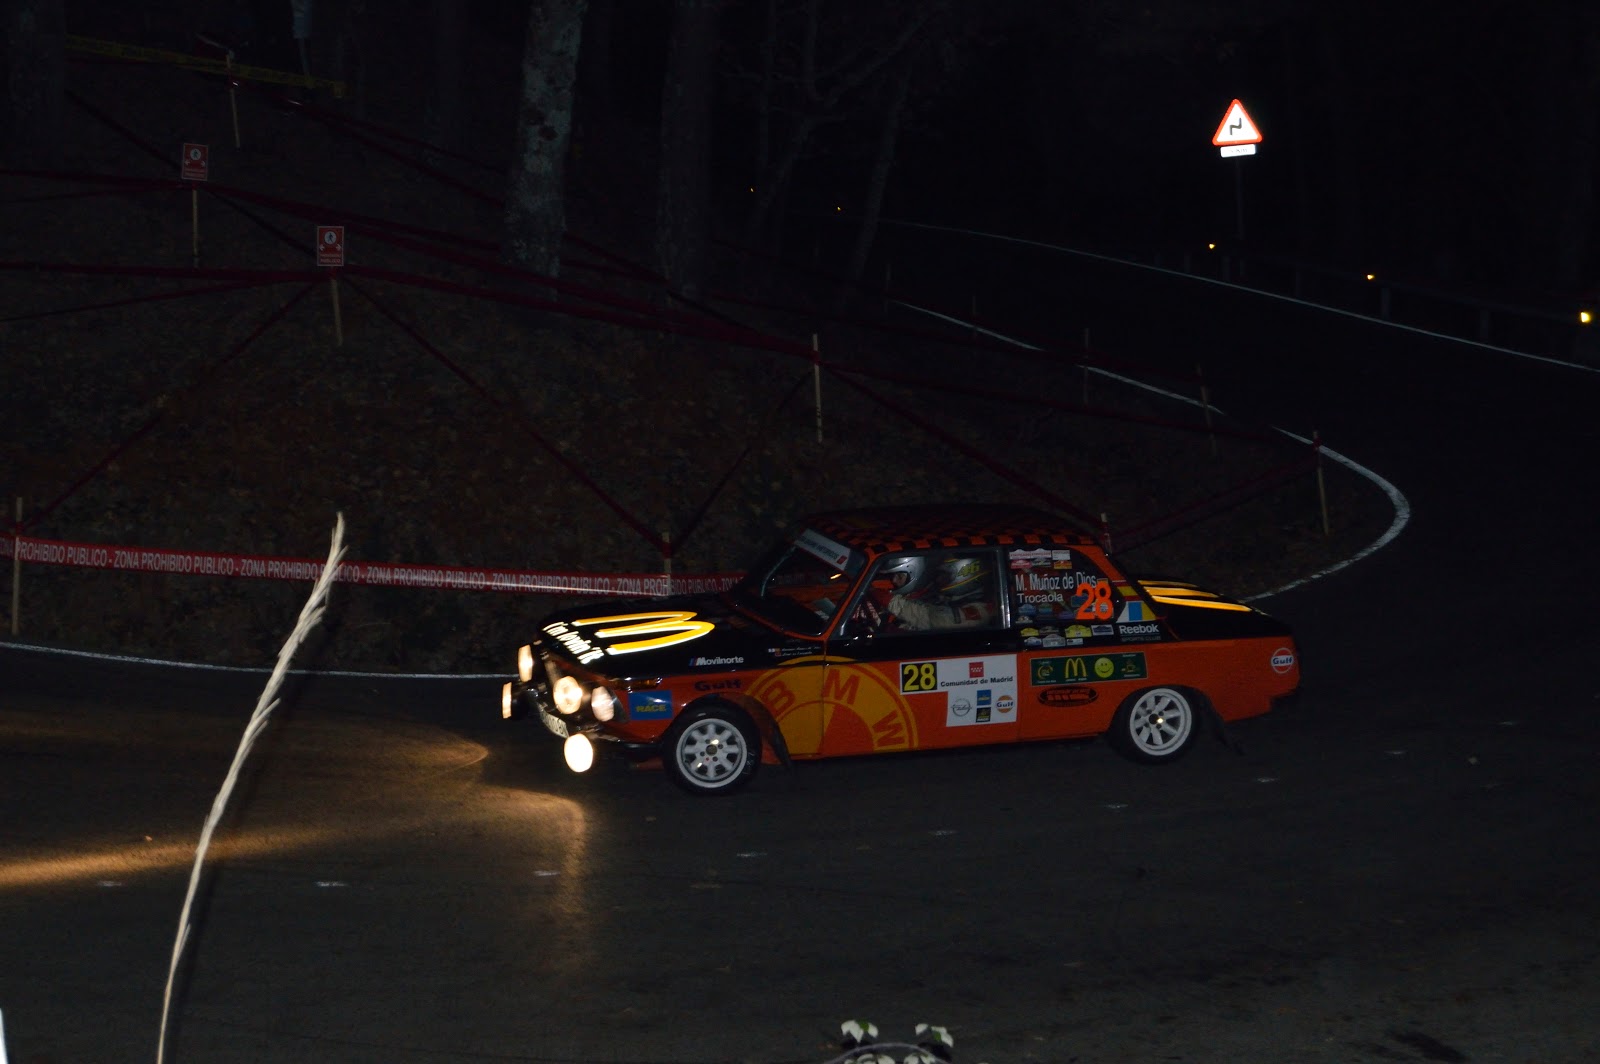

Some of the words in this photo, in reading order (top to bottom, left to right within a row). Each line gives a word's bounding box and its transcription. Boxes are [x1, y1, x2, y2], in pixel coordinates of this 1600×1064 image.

[17, 540, 65, 563] PROHIBIDO
[67, 549, 108, 568] PUBLICO
[113, 550, 139, 568] ZONA
[141, 552, 192, 573] PROHIBIDO
[193, 555, 234, 575] PUBLICO
[240, 558, 266, 577] ZONA
[267, 560, 317, 581] PROHIBIDO
[320, 563, 360, 582] PLICO
[366, 565, 392, 584] ZONA
[393, 566, 443, 588] PROHIBIDO
[445, 570, 486, 589] PUBLICO
[491, 573, 517, 592] ZONA
[519, 574, 569, 594] PROHIBIDO
[571, 576, 610, 595] PUBLICO
[617, 577, 642, 595] ZONA
[1015, 574, 1027, 591] M.
[1029, 572, 1060, 591] Muñoz
[1062, 573, 1074, 589] de
[1076, 571, 1097, 588] Dios
[1017, 592, 1064, 604] Trocaola
[1076, 582, 1114, 621] 28
[1118, 624, 1160, 635] Reebok
[695, 656, 745, 667] Movilnorte
[1272, 656, 1293, 665] Gulf
[903, 662, 937, 691] 28
[694, 679, 741, 691] Gulf
[940, 680, 979, 688] Comunidad
[635, 704, 667, 713] RACE
